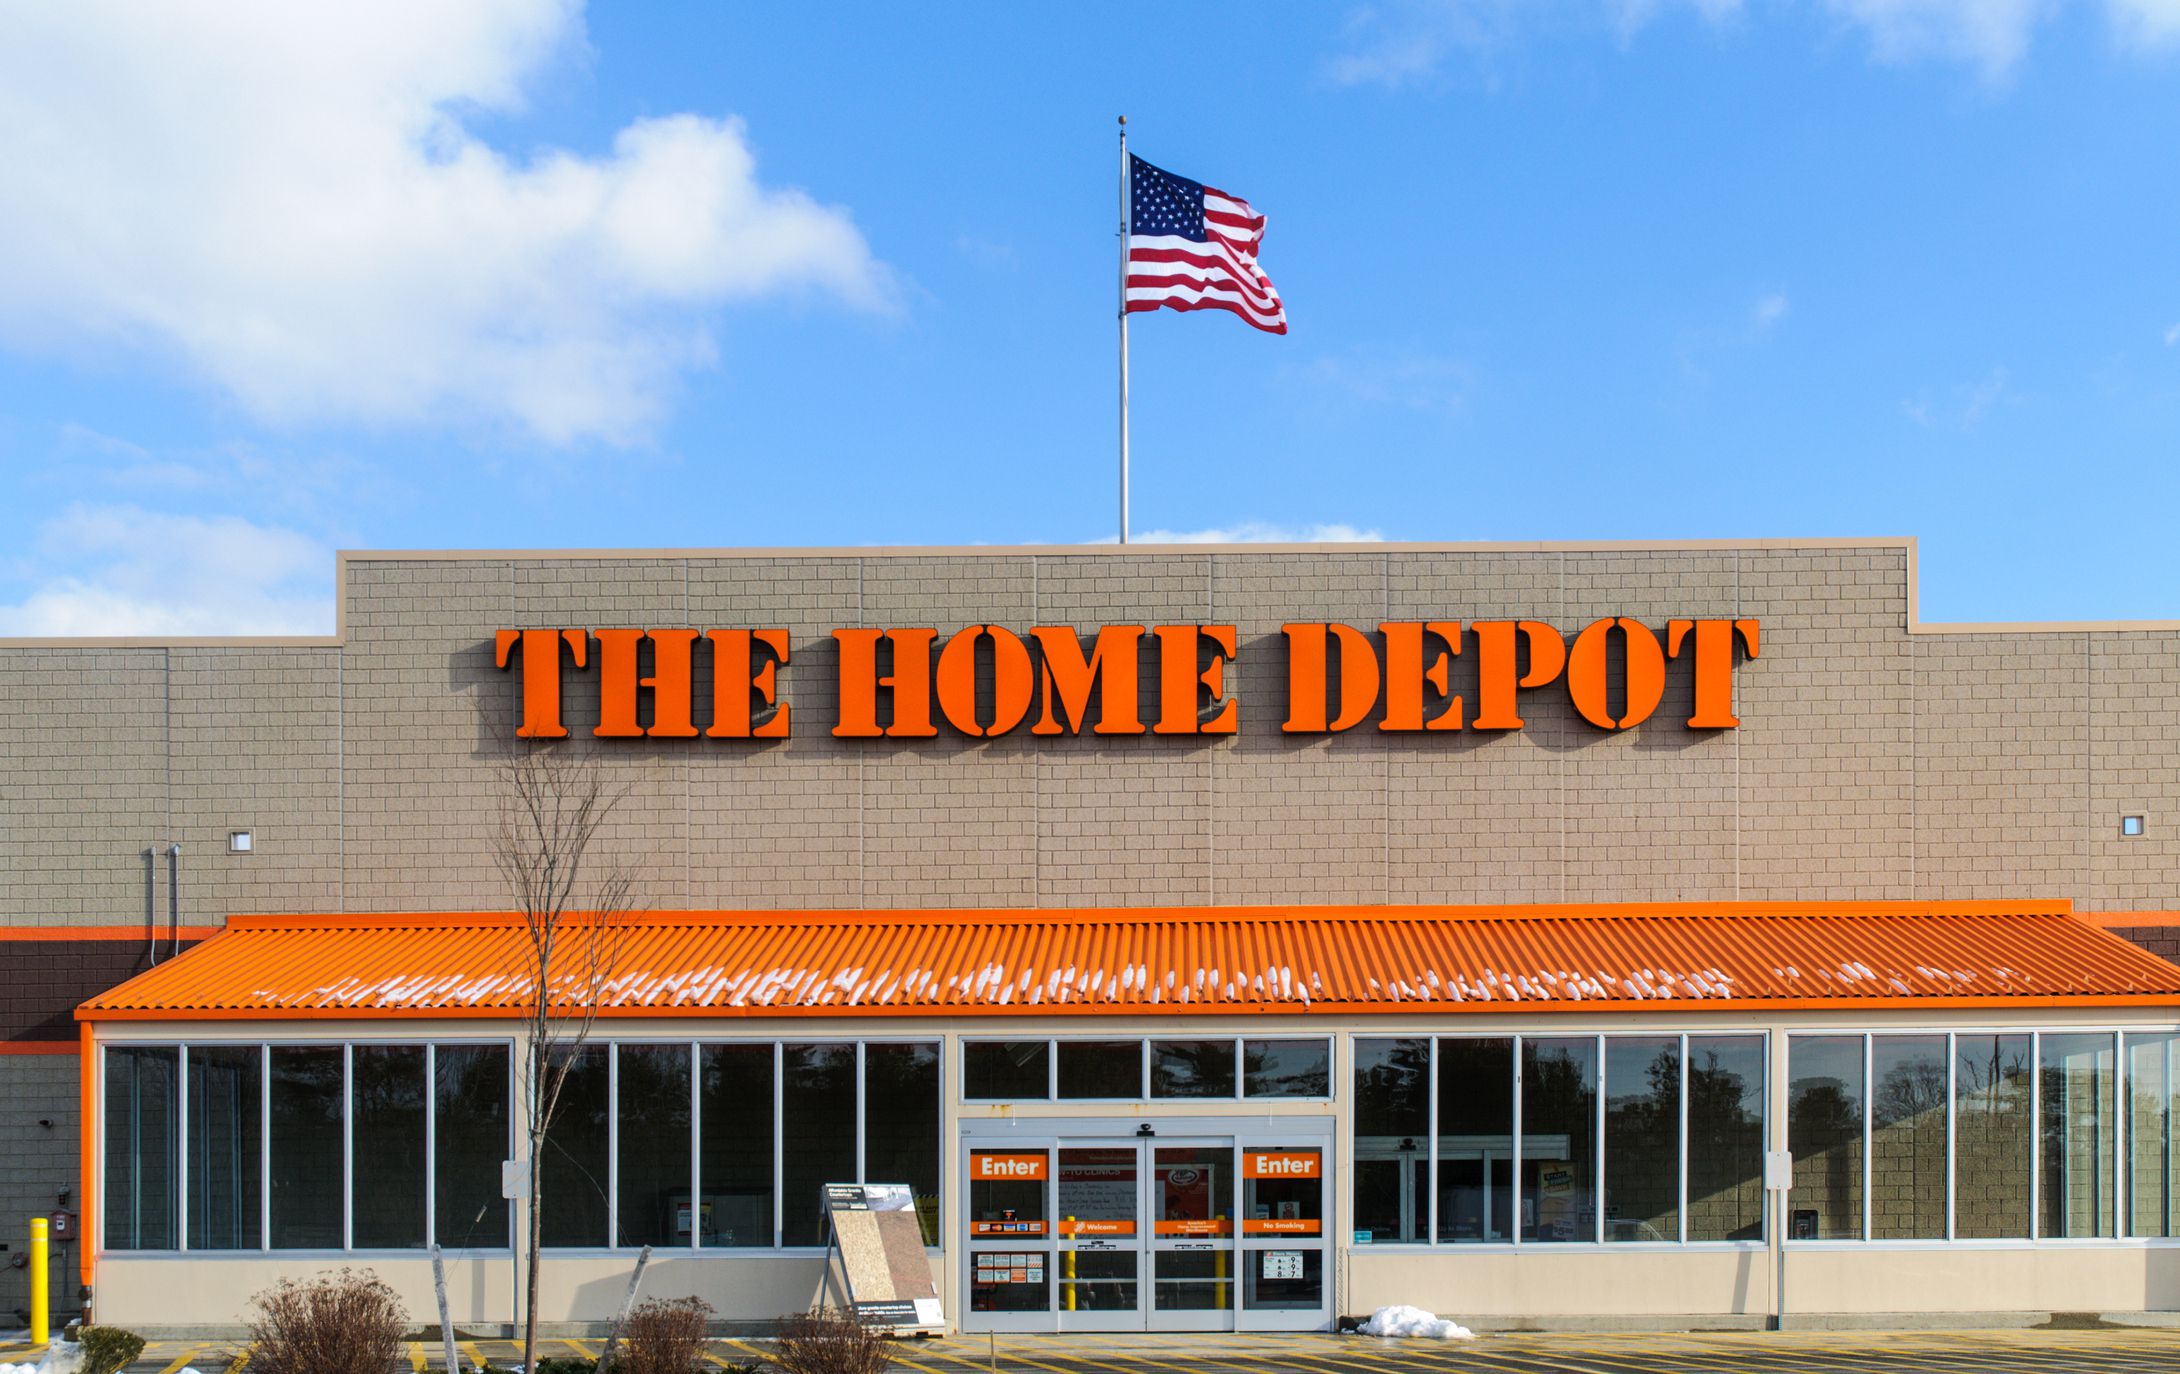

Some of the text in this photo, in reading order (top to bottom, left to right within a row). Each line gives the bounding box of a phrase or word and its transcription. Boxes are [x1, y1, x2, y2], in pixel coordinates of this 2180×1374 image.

[496, 616, 1761, 739] THE HOME DEPOT
[981, 1157, 1040, 1176] Enter
[1256, 1155, 1314, 1174] Enter
[1087, 1223, 1118, 1231] Welcome
[1275, 1222, 1305, 1230] Smoking
